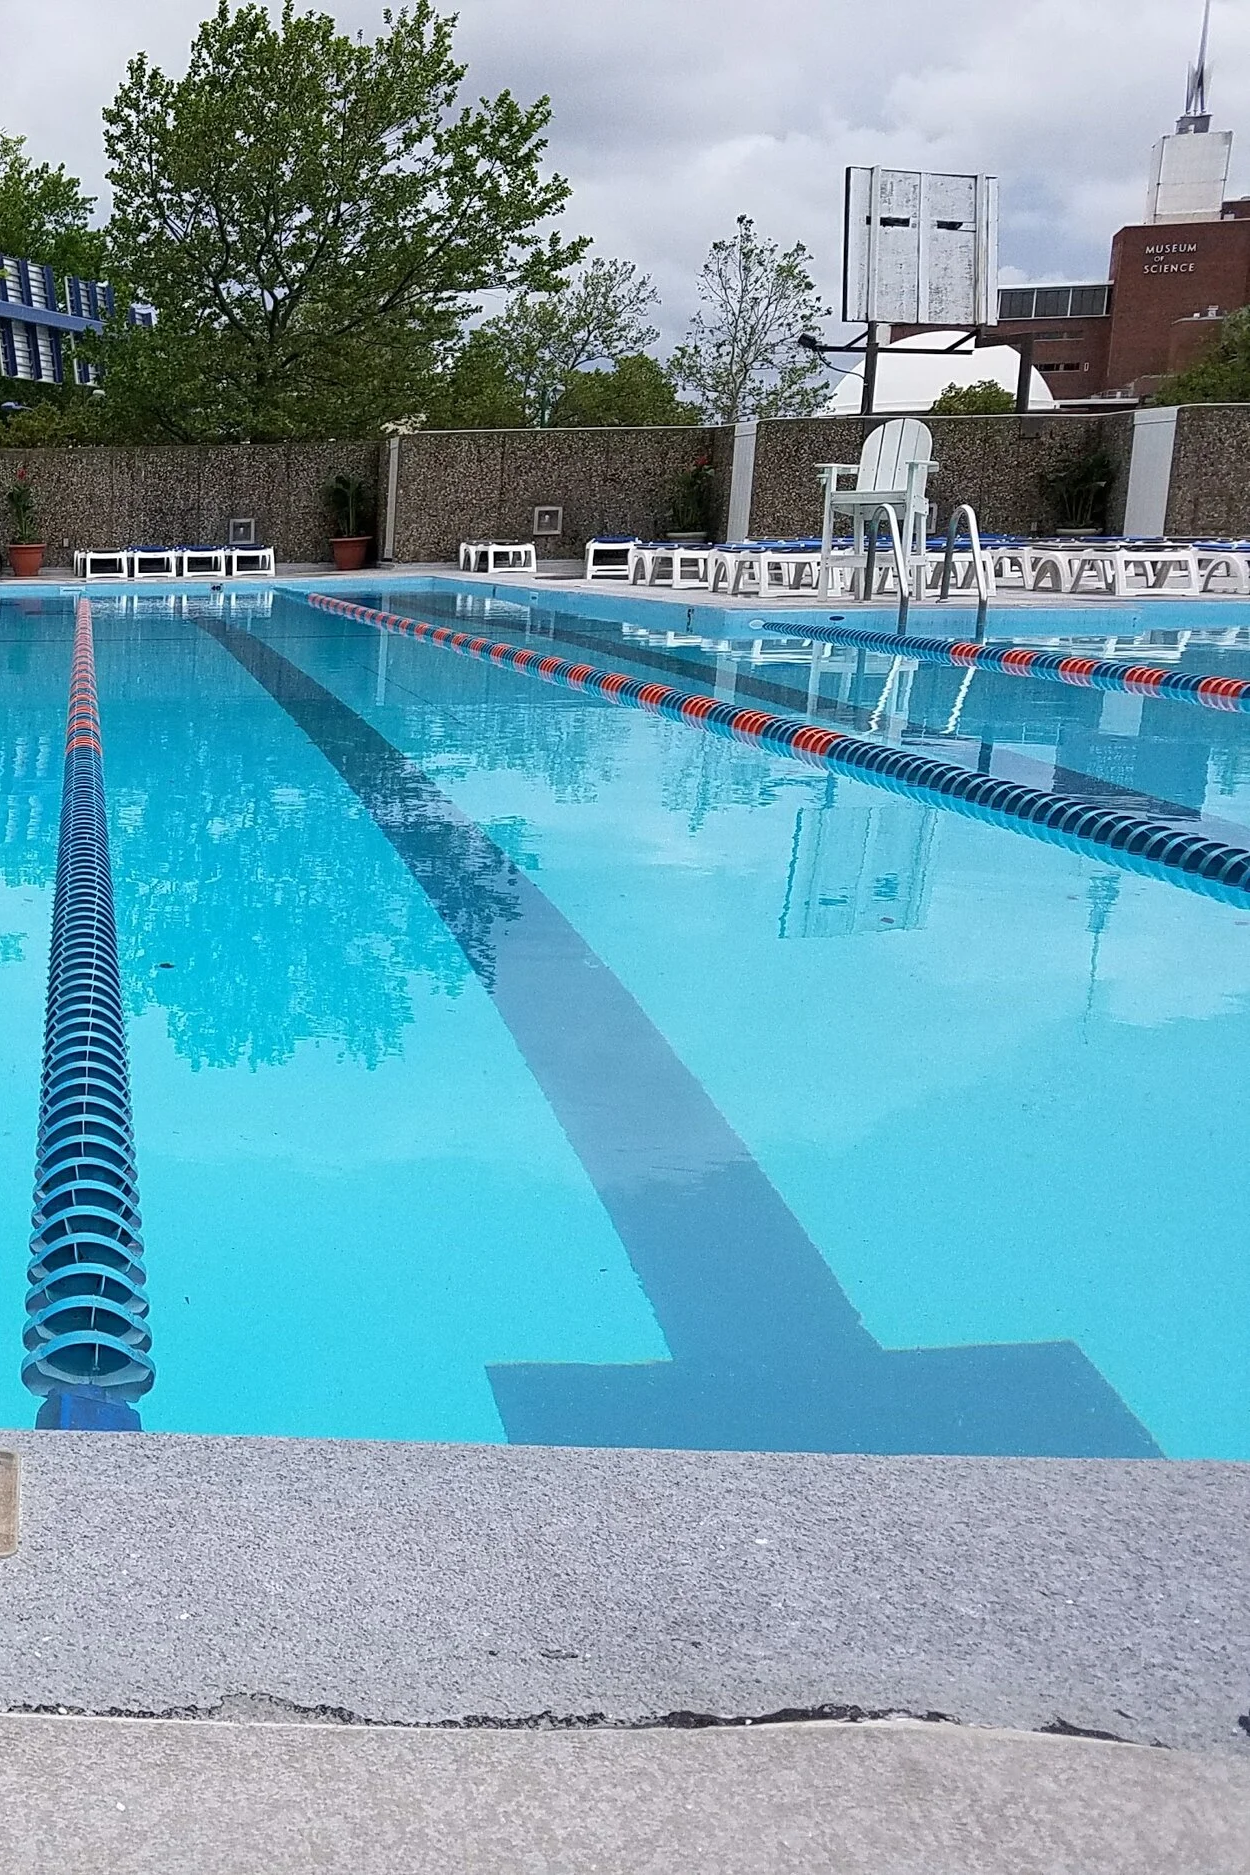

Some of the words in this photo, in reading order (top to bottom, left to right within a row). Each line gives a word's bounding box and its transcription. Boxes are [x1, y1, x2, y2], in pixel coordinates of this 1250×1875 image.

[1145, 243, 1197, 254] MUSEUM
[1153, 255, 1165, 263] OF
[1143, 263, 1196, 274] SCIENCE
